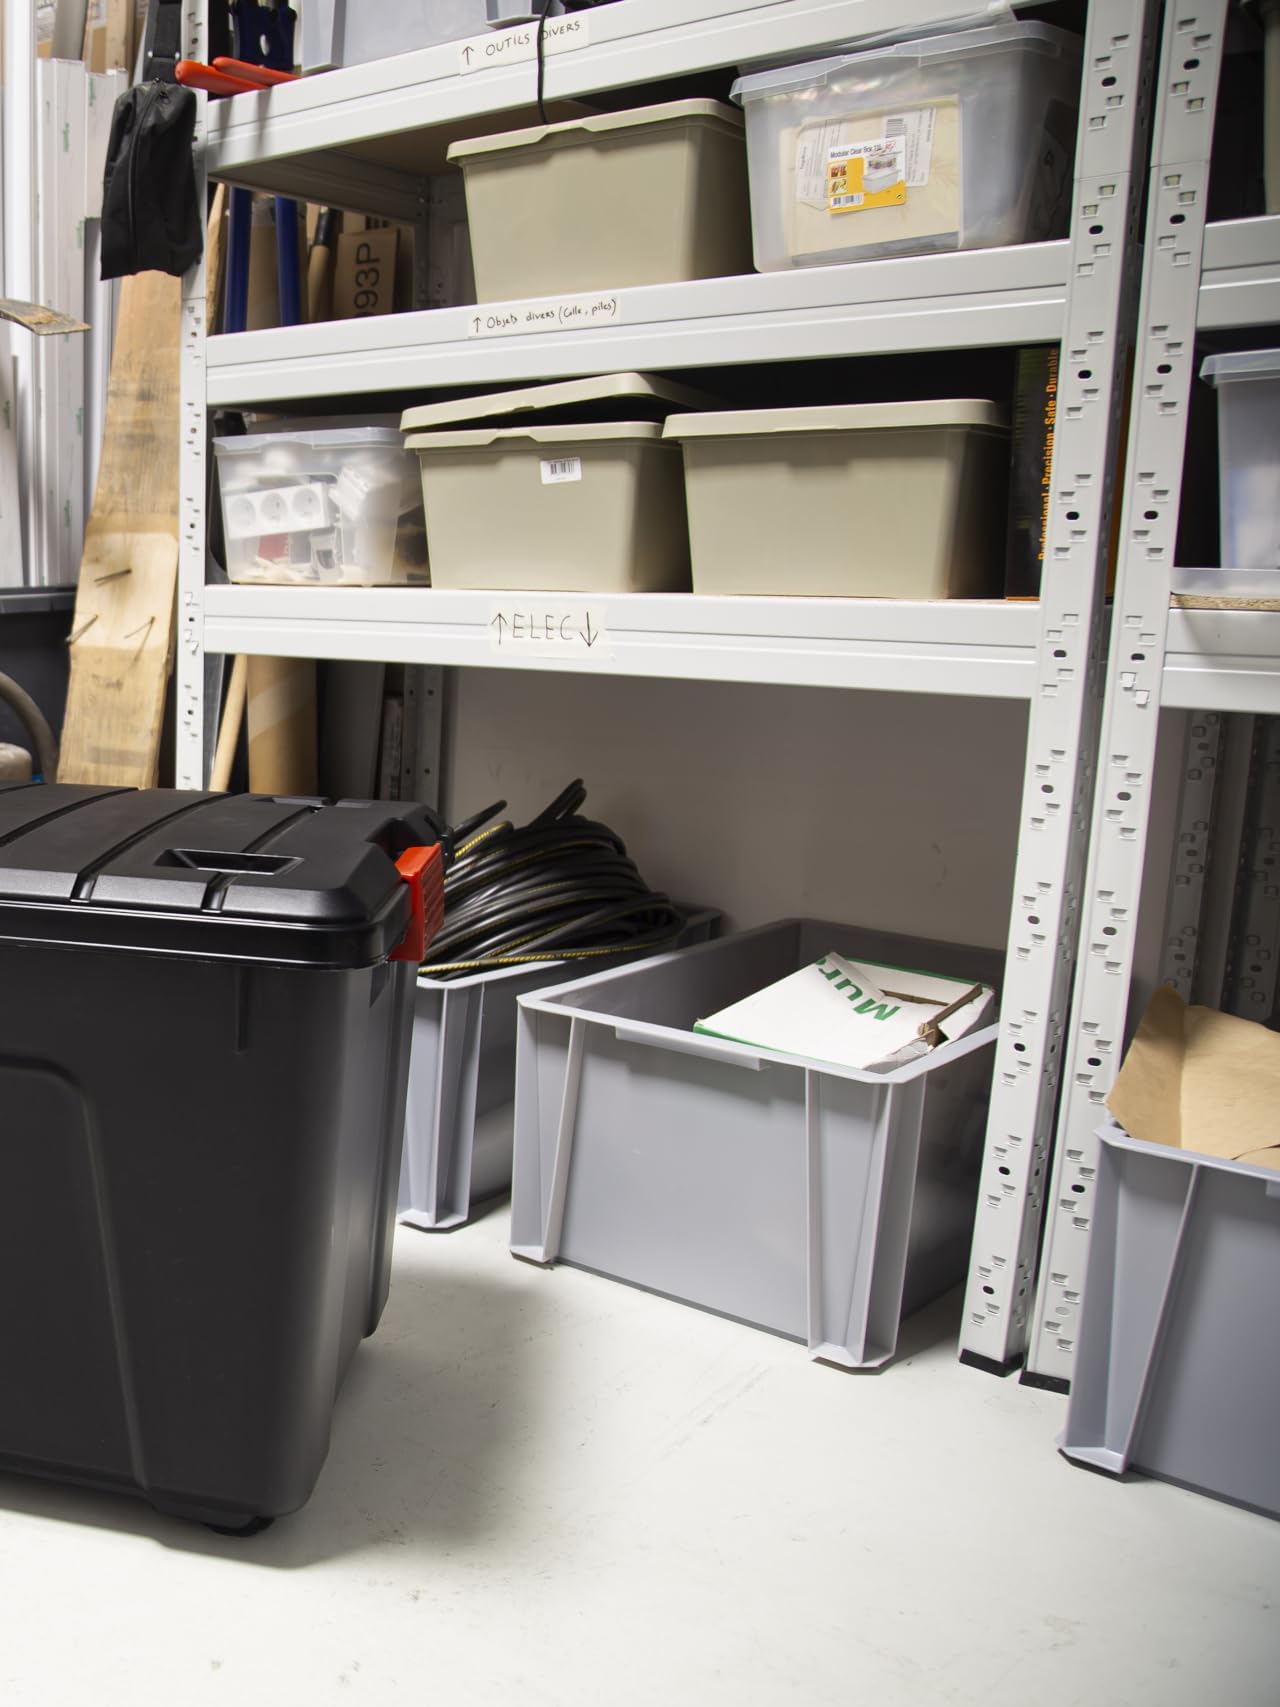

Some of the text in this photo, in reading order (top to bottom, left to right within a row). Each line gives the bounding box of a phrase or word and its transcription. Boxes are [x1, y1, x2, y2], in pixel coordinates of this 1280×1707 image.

[485, 21, 581, 56] OUTILS DIVERS
[353, 242, 381, 316] 93P
[1044, 400, 1056, 425] Safe
[512, 612, 574, 641] ELEC
